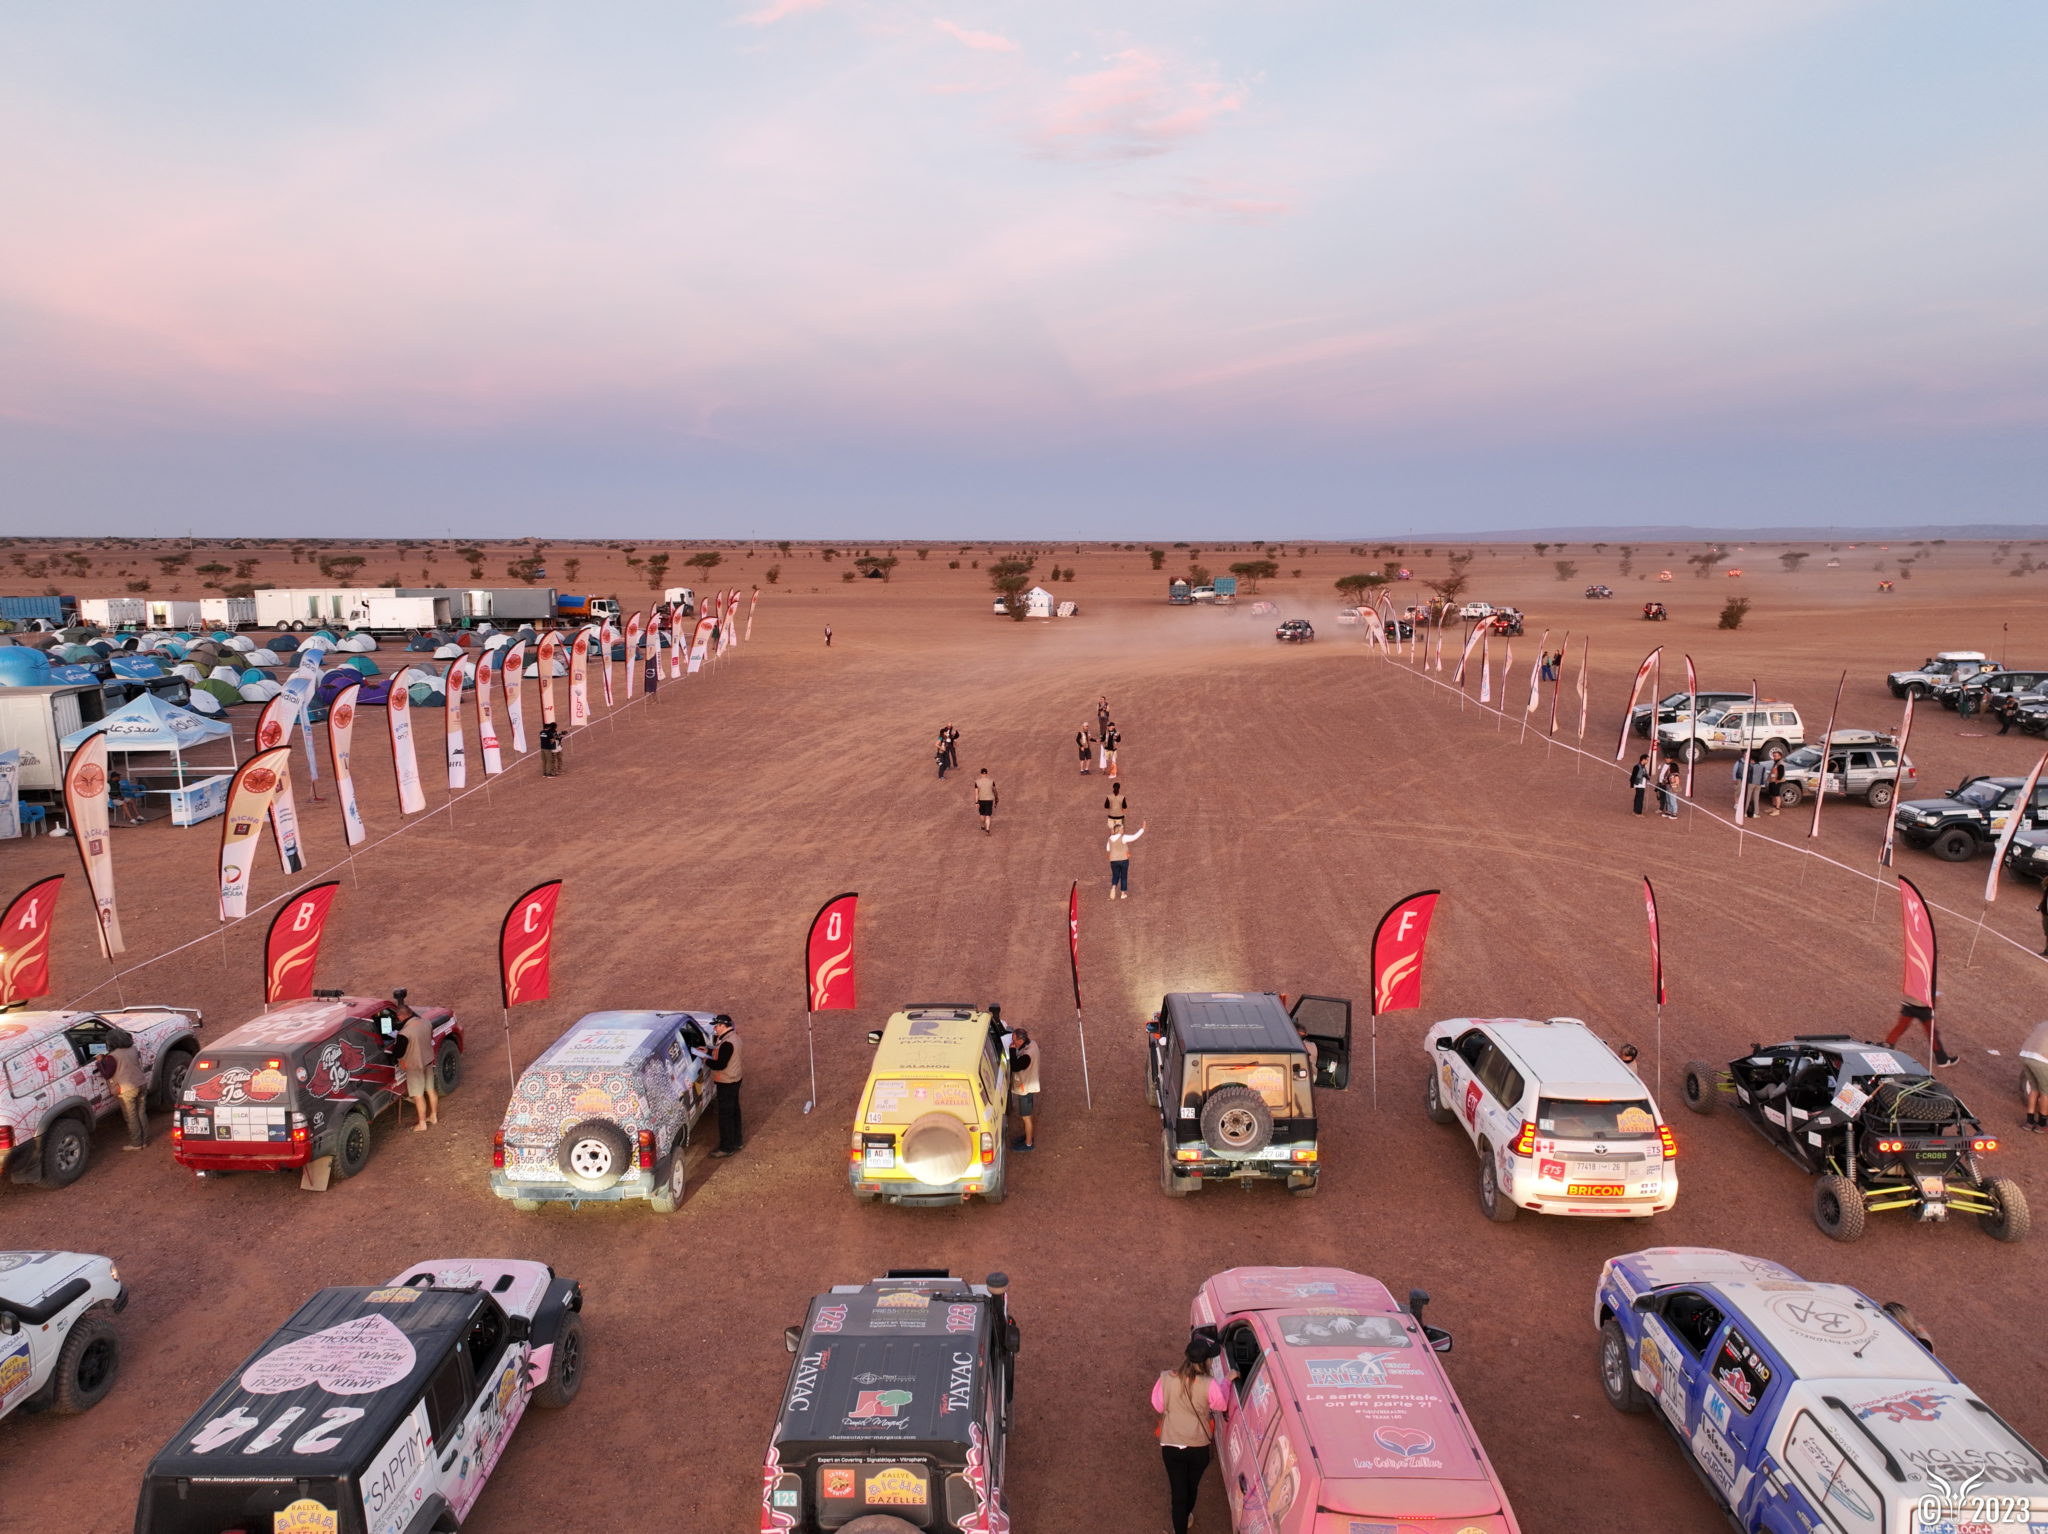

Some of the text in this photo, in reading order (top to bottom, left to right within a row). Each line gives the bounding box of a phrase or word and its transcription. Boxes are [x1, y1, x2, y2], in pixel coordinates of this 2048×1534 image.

[18, 898, 38, 931] A
[292, 902, 315, 932] B
[523, 902, 543, 934] C
[1396, 911, 1418, 942] F
[868, 1113, 882, 1123] 149
[1181, 1108, 1195, 1118] 125
[1915, 1152, 1948, 1160] E-CROSS
[1568, 1185, 1625, 1196] BRICON
[812, 1303, 849, 1333] 123
[945, 1304, 977, 1333] 123
[788, 1352, 823, 1412] TAYAC
[947, 1352, 973, 1411] TAYAC
[1373, 1401, 1414, 1409] parle
[190, 1406, 365, 1455] 214
[841, 1456, 863, 1464] Covering
[1900, 1448, 2030, 1466] CUSTOM
[371, 1426, 426, 1512] SAPFIM
[191, 1475, 294, 1483] www.bumperoffroad.com
[868, 1478, 924, 1496] AICHA
[774, 1491, 798, 1506] 123
[867, 1496, 925, 1504] GAZELLES
[276, 1512, 335, 1531] AICHA
